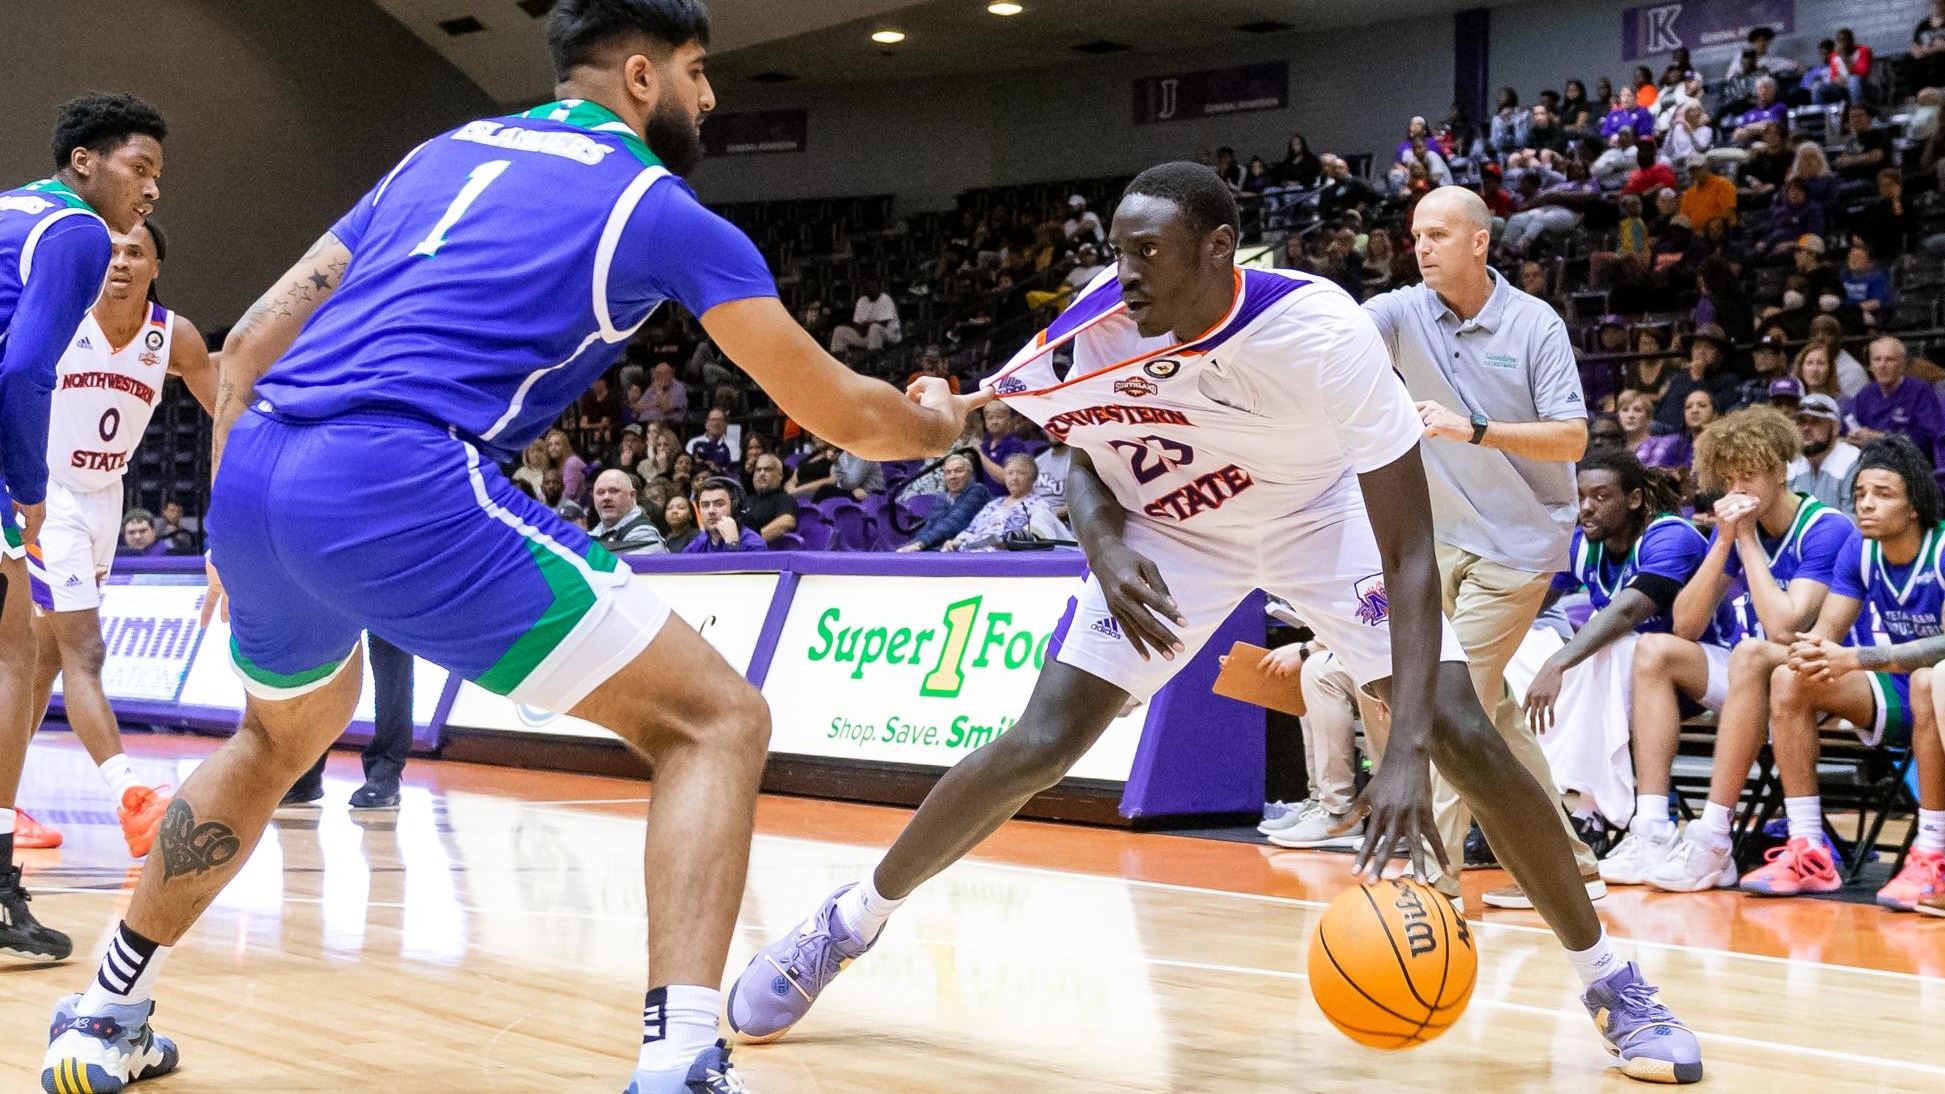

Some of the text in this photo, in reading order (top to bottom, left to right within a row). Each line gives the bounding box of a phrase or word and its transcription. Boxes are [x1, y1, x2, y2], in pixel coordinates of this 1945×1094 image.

[1648, 4, 1682, 52] K
[1158, 79, 1178, 119] J
[450, 120, 616, 166] ISLANDERS
[408, 160, 512, 259] 1
[61, 371, 156, 407] NORTHWESTERN
[99, 407, 120, 442] 0
[71, 450, 126, 472] STATE
[1107, 434, 1194, 485] 23
[1143, 463, 1254, 522] STATE
[808, 608, 935, 679] Super
[919, 595, 983, 698] 1
[1091, 623, 1122, 640] adidas
[827, 716, 876, 747] Shop.
[881, 716, 939, 746] Save.
